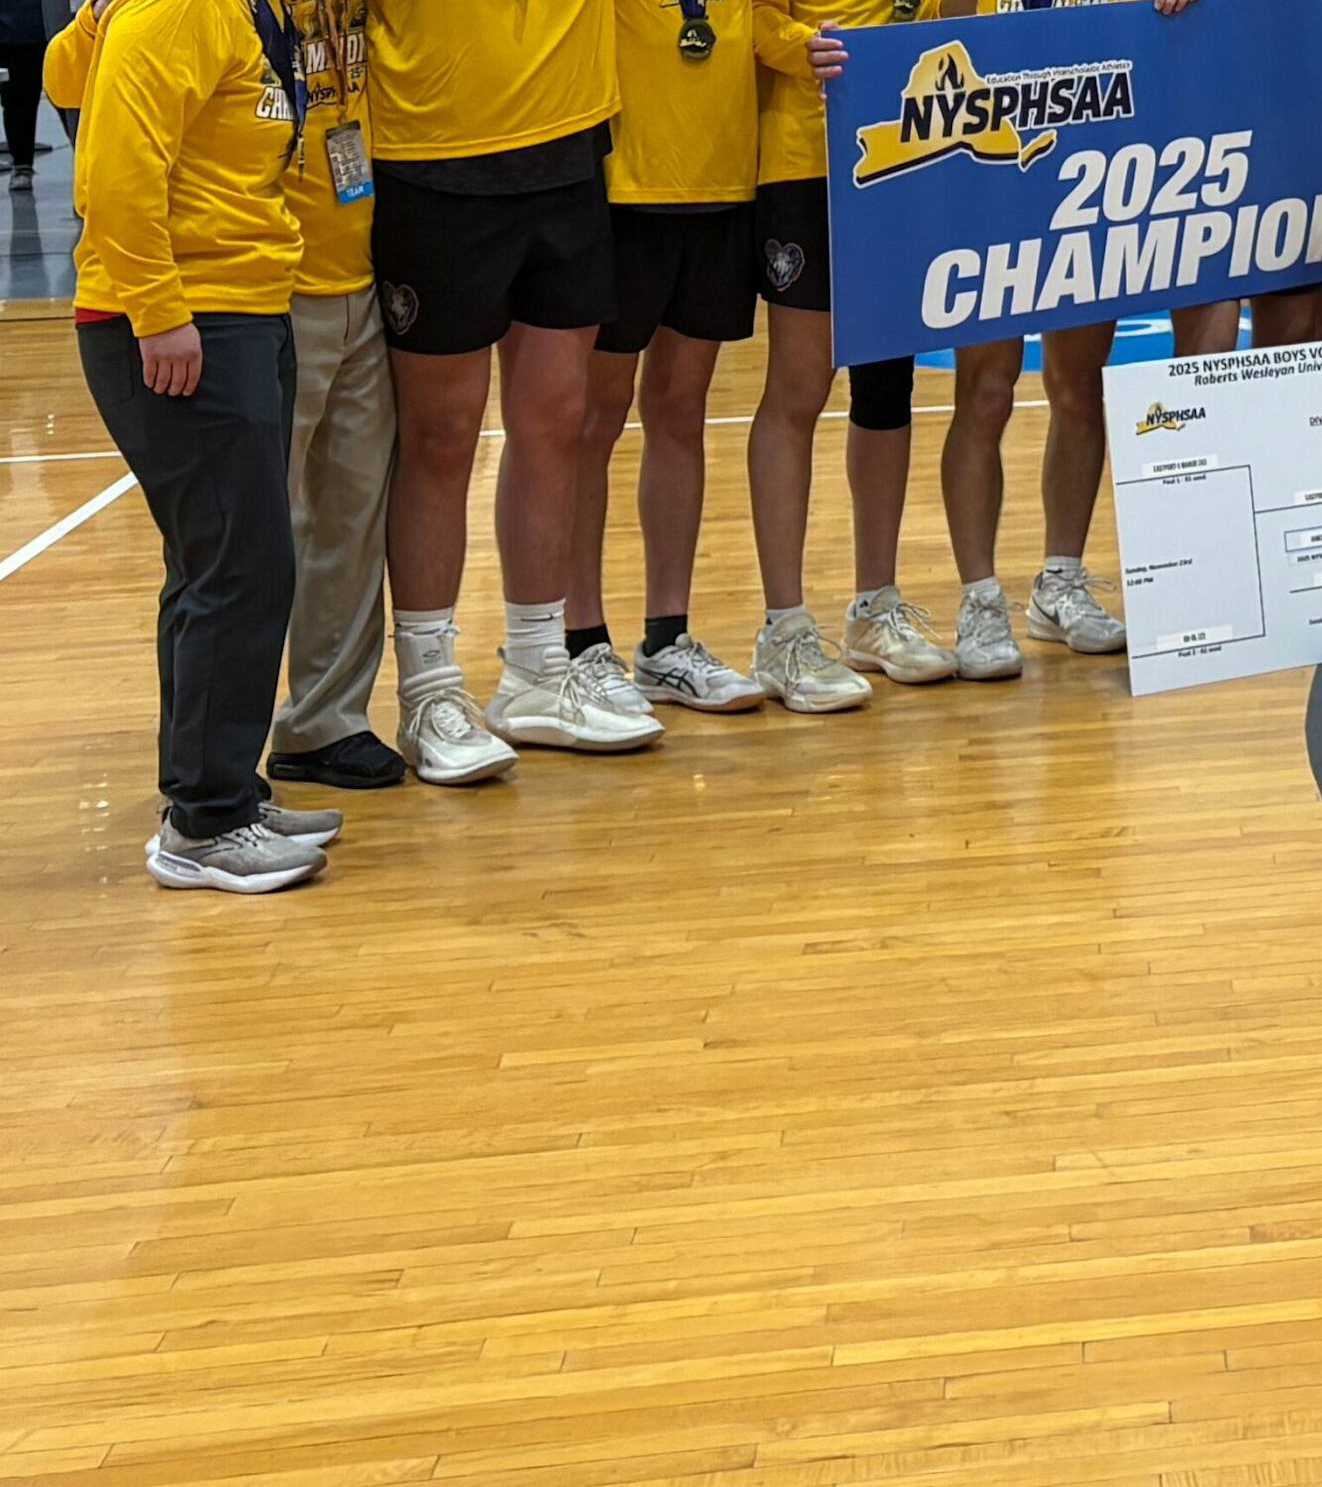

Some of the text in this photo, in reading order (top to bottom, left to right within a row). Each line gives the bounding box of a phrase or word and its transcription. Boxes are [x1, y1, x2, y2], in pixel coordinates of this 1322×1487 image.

[900, 70, 1134, 144] NYSPHSAA
[1050, 130, 1252, 231] 2025
[1168, 361, 1199, 377] 2025
[1203, 352, 1270, 372] NYSPHSAA
[1273, 349, 1307, 364] BOYS
[1194, 371, 1238, 386] Roberts
[1241, 364, 1295, 380] Wesleyan
[1146, 406, 1206, 425] NYSPHSAA
